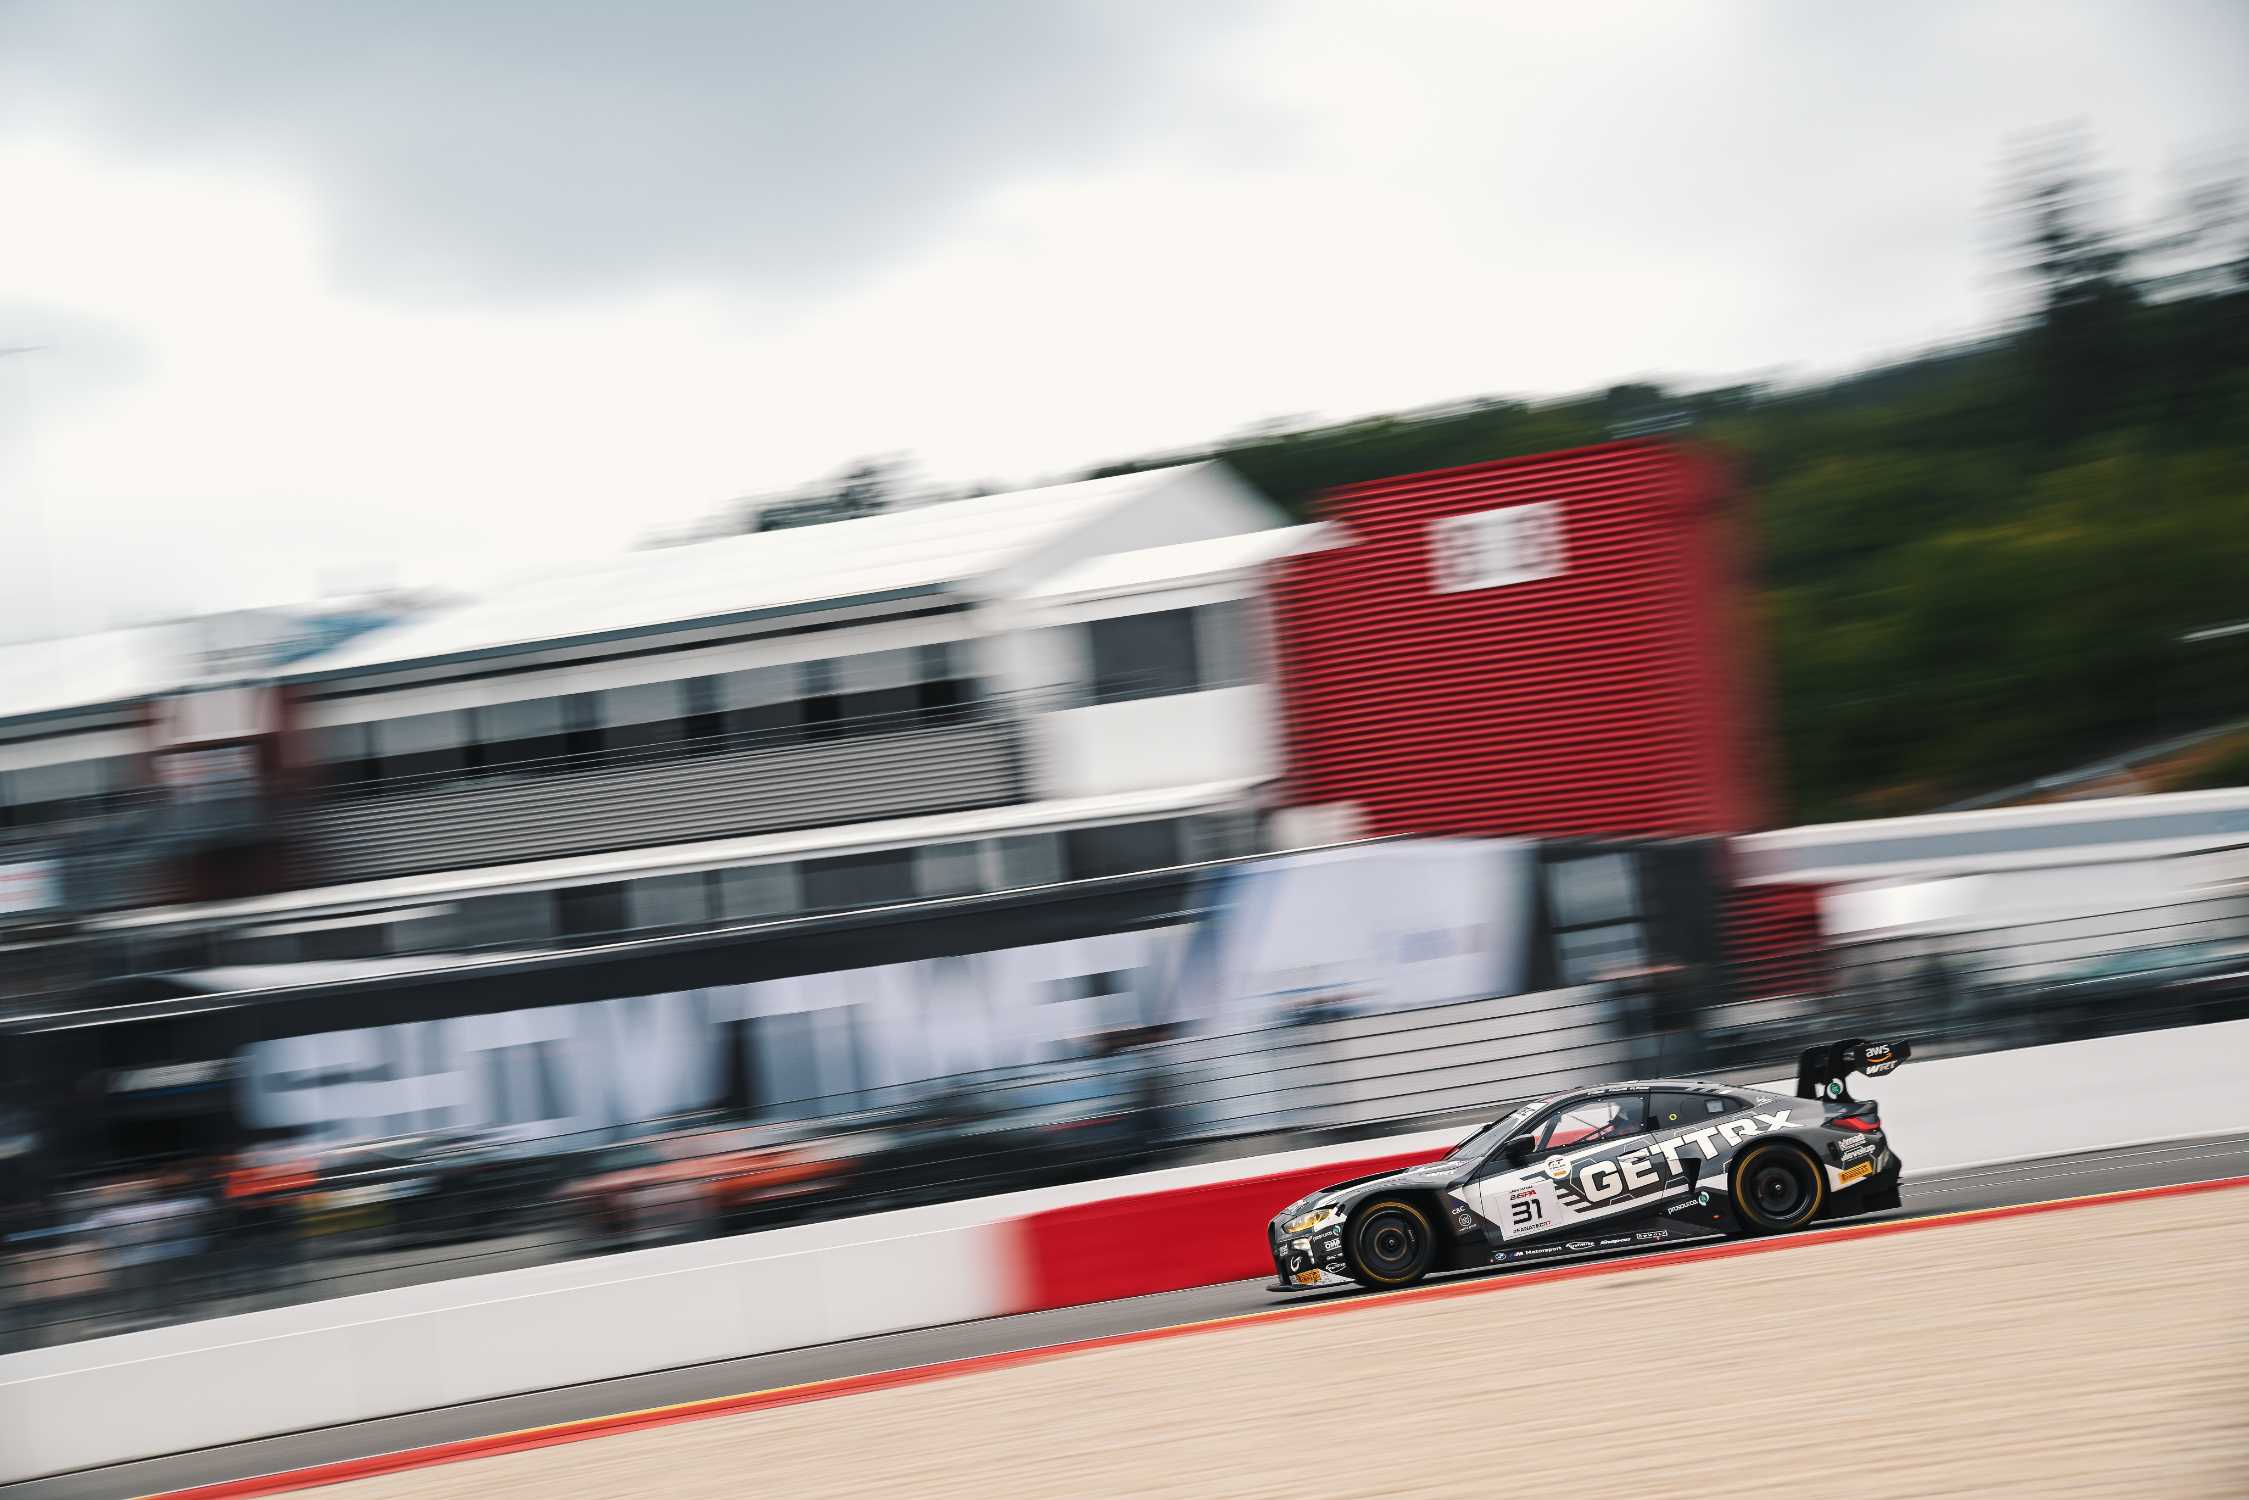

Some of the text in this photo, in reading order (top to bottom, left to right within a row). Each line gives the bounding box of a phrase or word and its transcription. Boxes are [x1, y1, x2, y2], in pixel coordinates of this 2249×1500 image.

[1865, 1044, 1890, 1058] aws
[1866, 1060, 1898, 1075] WRT
[1579, 1109, 1804, 1202] GETTRX
[1511, 1198, 1543, 1225] 31
[1525, 1246, 1562, 1255] Motorsport
